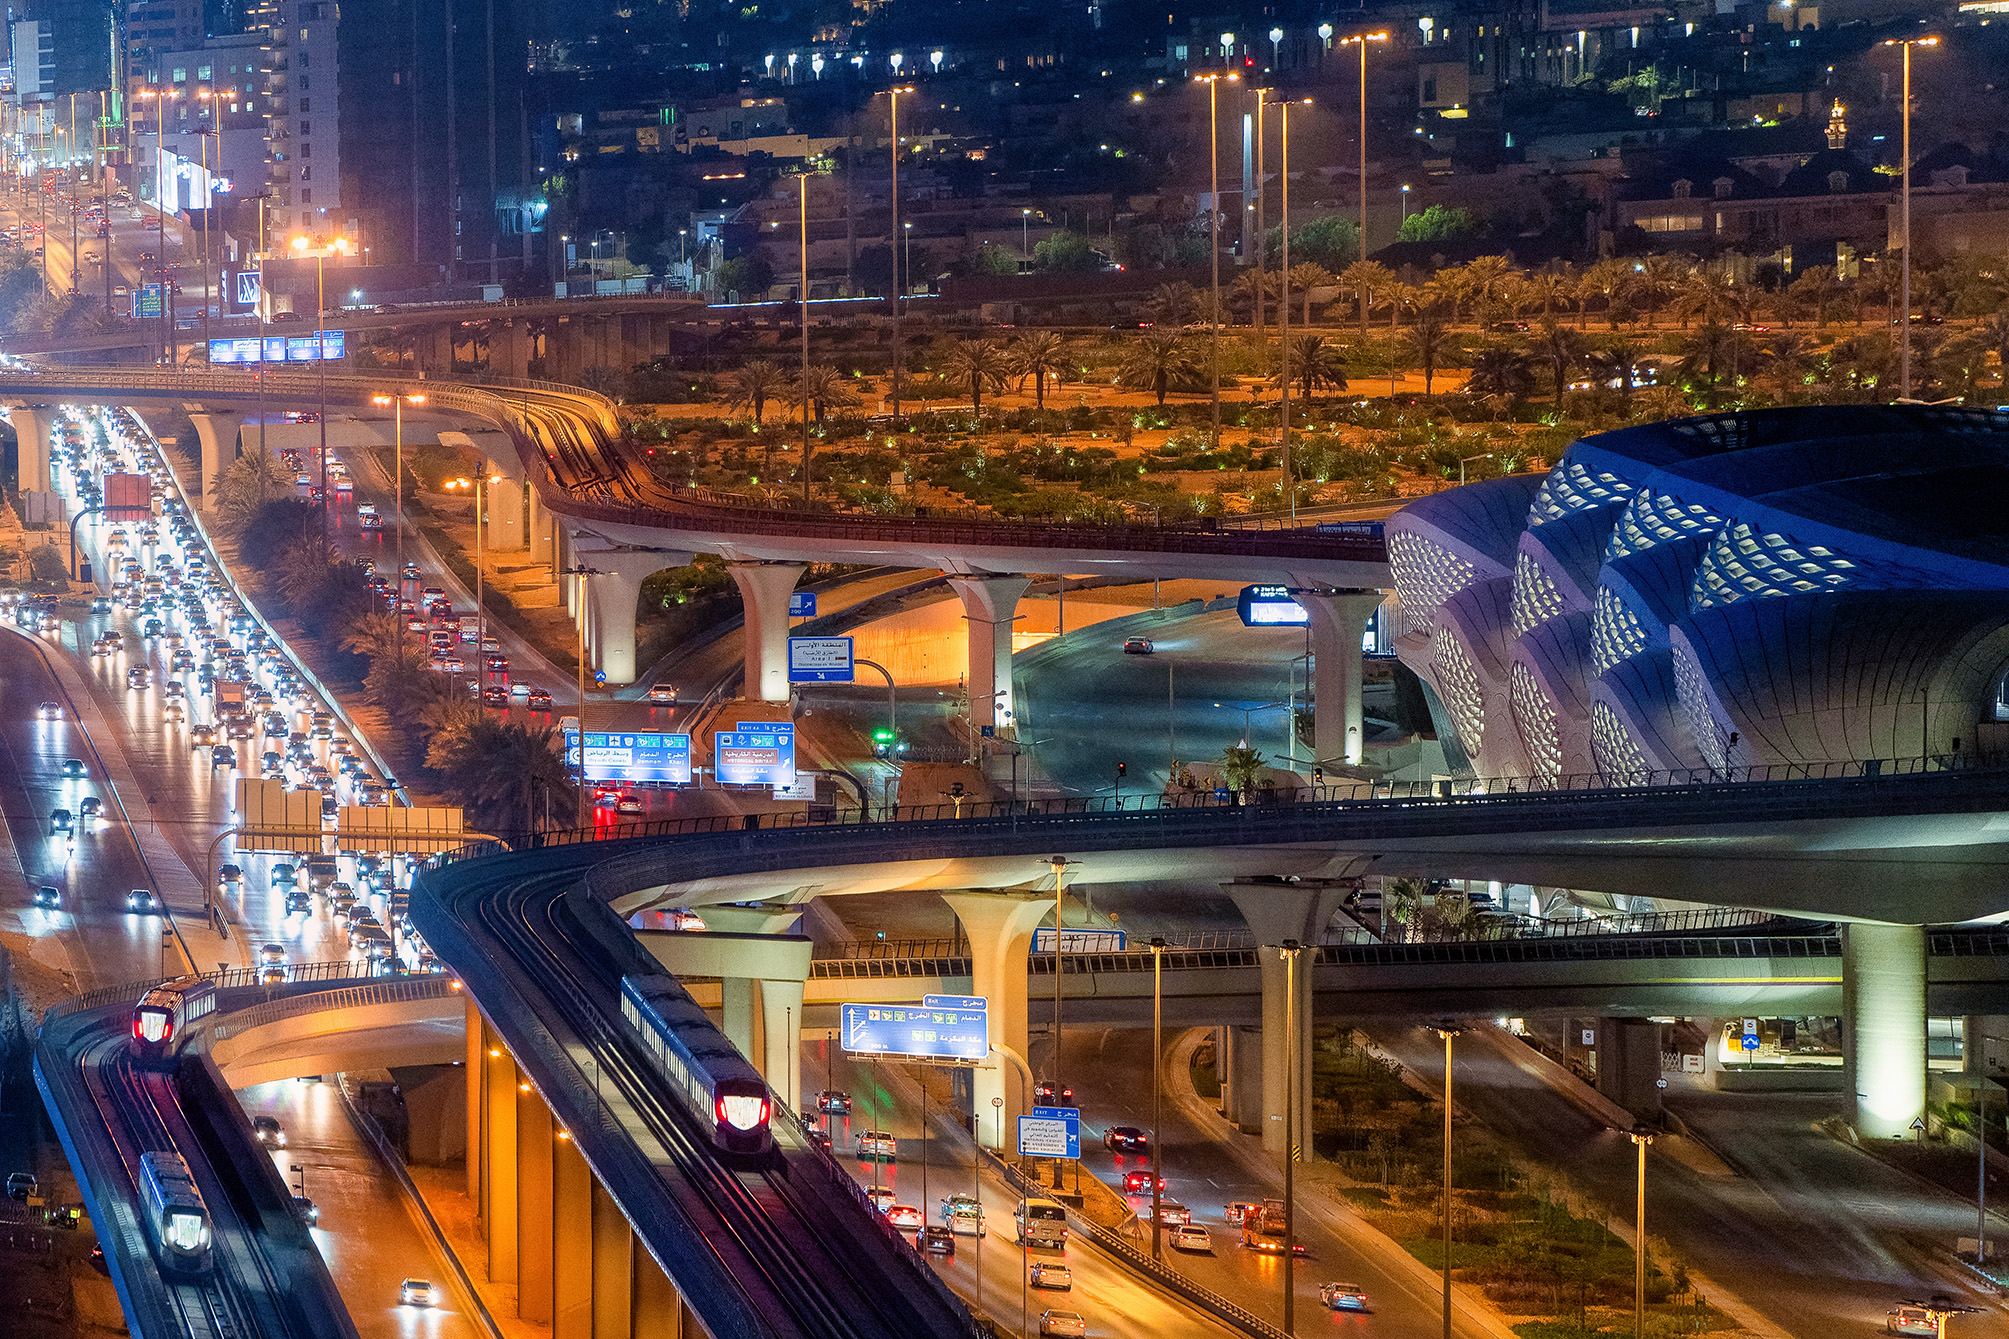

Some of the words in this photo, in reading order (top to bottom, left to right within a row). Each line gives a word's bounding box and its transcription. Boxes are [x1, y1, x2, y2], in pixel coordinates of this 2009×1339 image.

[639, 751, 660, 759] الدمام
[908, 1012, 930, 1020] الخرج
[960, 1014, 982, 1022] الدمام
[939, 1035, 966, 1043] المكرمة
